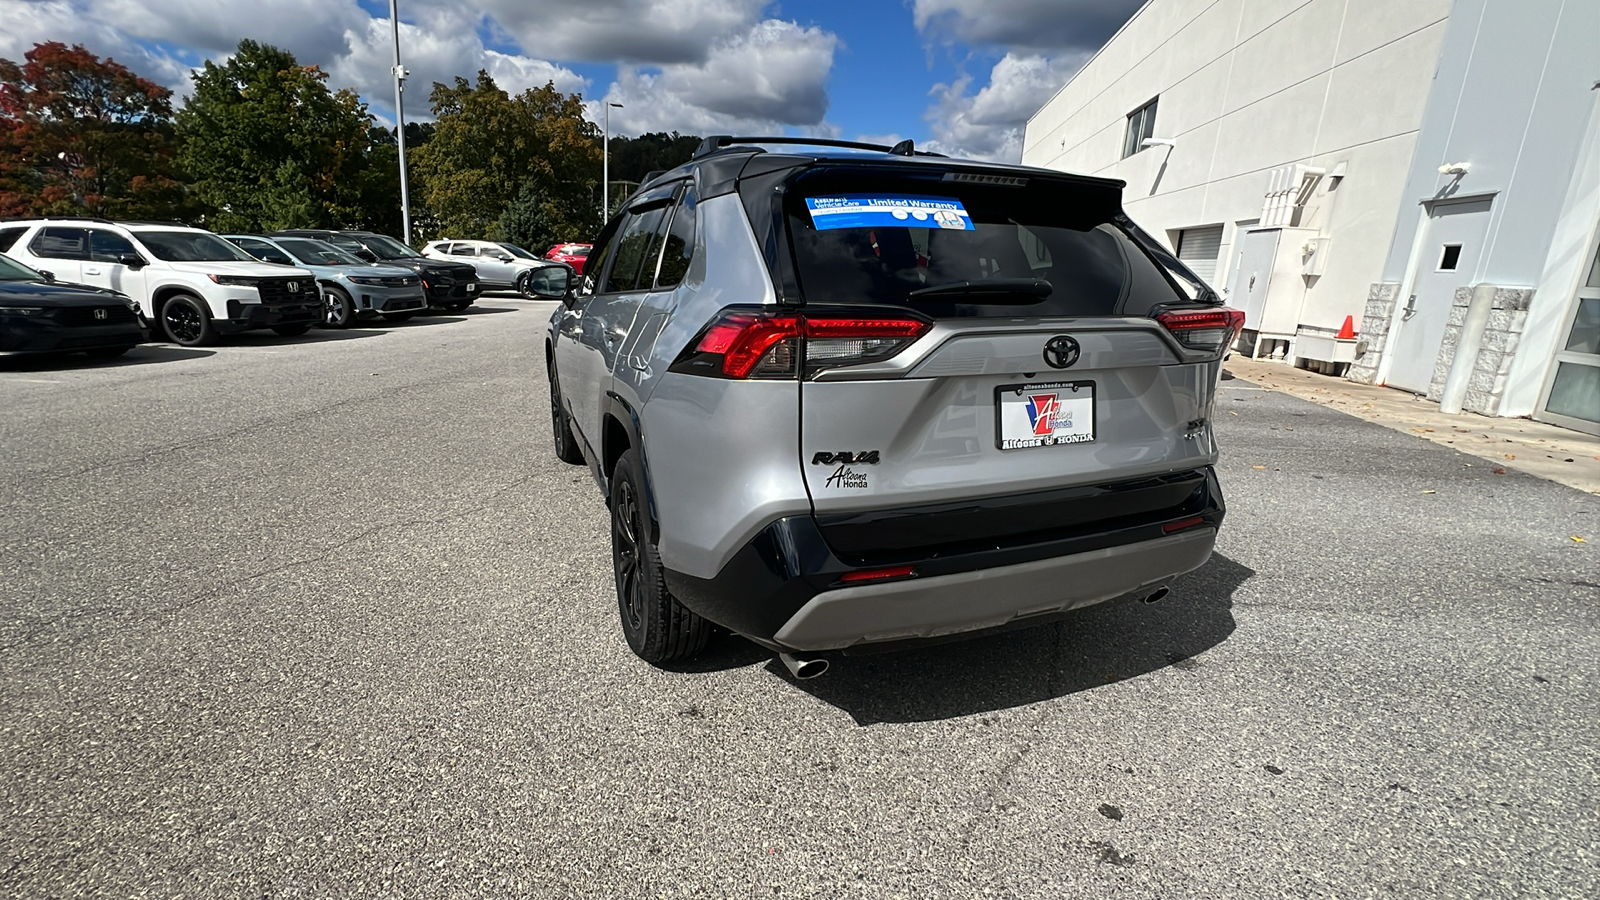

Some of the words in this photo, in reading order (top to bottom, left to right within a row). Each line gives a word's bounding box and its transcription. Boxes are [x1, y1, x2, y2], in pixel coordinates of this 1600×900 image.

[867, 199, 908, 207] Limited
[910, 200, 957, 210] Warranty
[1002, 440, 1042, 449] Altoona
[1057, 434, 1094, 443] HONDA
[812, 450, 879, 464] RAV4
